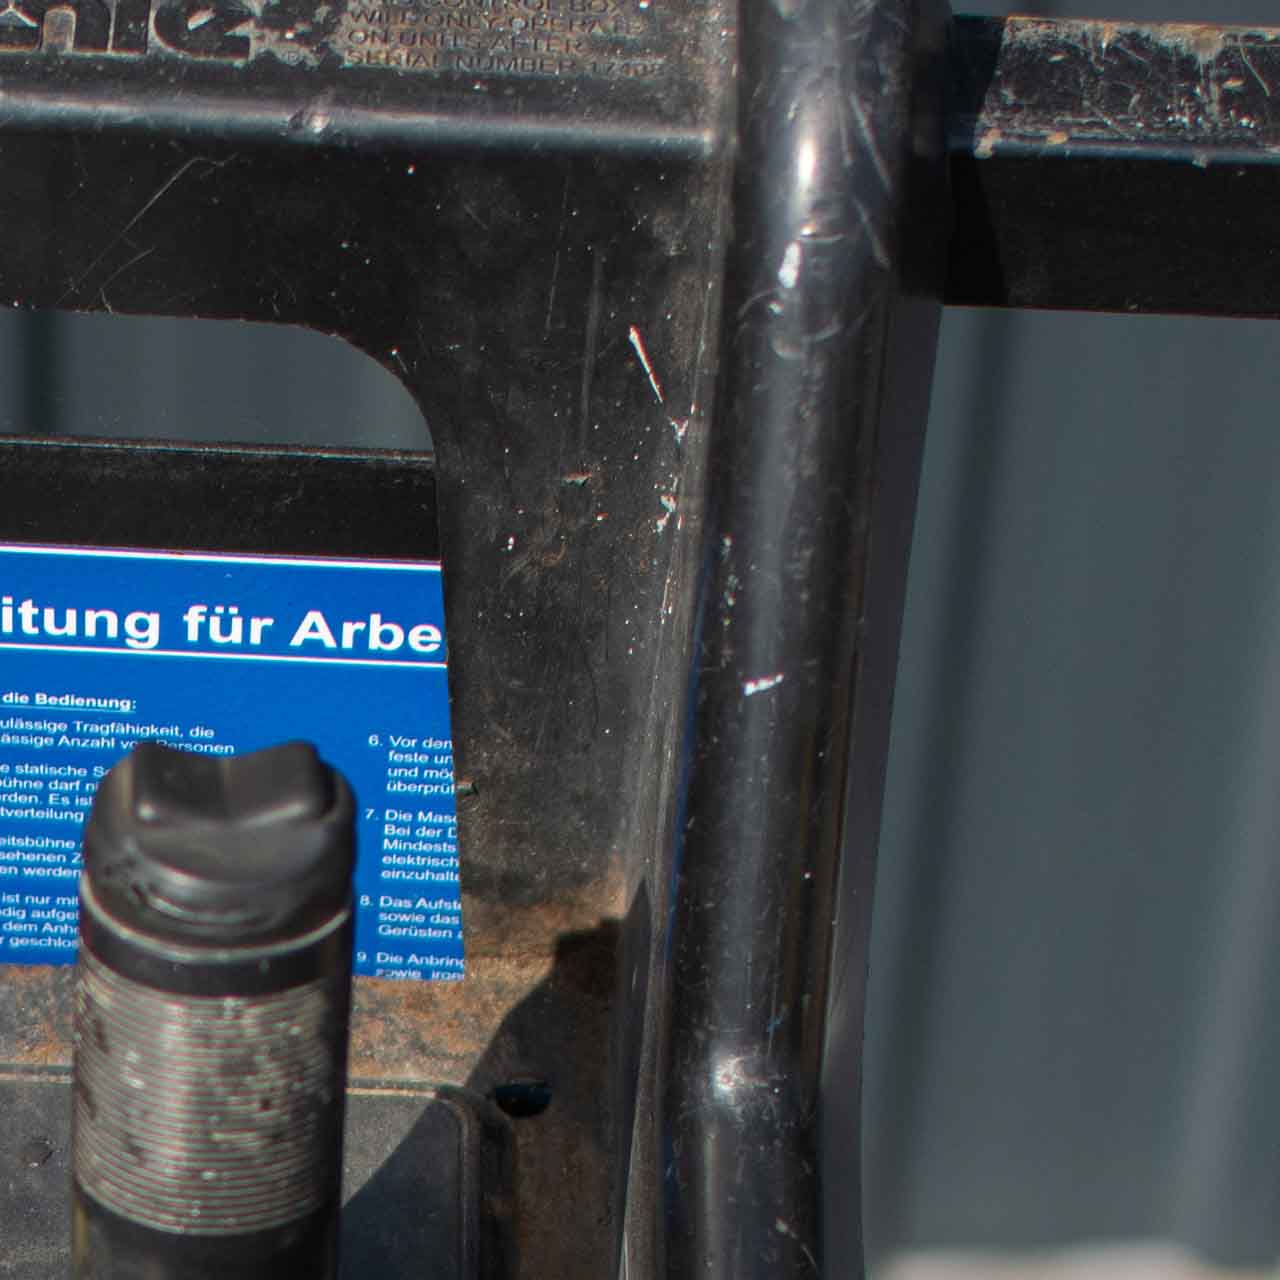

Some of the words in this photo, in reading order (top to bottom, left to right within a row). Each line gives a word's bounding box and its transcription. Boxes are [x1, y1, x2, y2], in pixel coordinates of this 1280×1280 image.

[423, 13, 500, 30] ONLY
[348, 29, 387, 46] ON
[398, 31, 481, 49] UNITS
[490, 34, 584, 55] AFTER
[346, 48, 439, 68] SERIAL
[455, 54, 576, 73] NUMBER
[182, 604, 274, 645] für
[289, 610, 442, 653] Arbe
[2, 692, 30, 704] die
[35, 692, 136, 711] Bedienung:
[73, 719, 184, 738] Tragfähigkeit,
[189, 725, 215, 738] die
[57, 735, 115, 749] Anzahl
[368, 734, 383, 747] 6.
[389, 735, 418, 748] Vor
[388, 750, 429, 763] feste
[15, 763, 88, 777] statische
[387, 766, 419, 777] und
[48, 779, 80, 791] darf
[48, 793, 70, 806] Es
[75, 795, 93, 807] ist
[365, 808, 380, 820] 7.
[385, 809, 413, 822] Die
[384, 824, 410, 837] Bei
[415, 825, 443, 838] der
[381, 854, 460, 868] elektrisch
[2, 891, 21, 904] ist
[25, 894, 50, 905] nur
[360, 894, 373, 907] 8.
[380, 895, 412, 909] Das
[378, 911, 425, 924] sowie
[430, 913, 460, 925] das
[2, 920, 38, 932] dem
[378, 924, 453, 938] Gerüsten
[376, 951, 403, 964] Die
